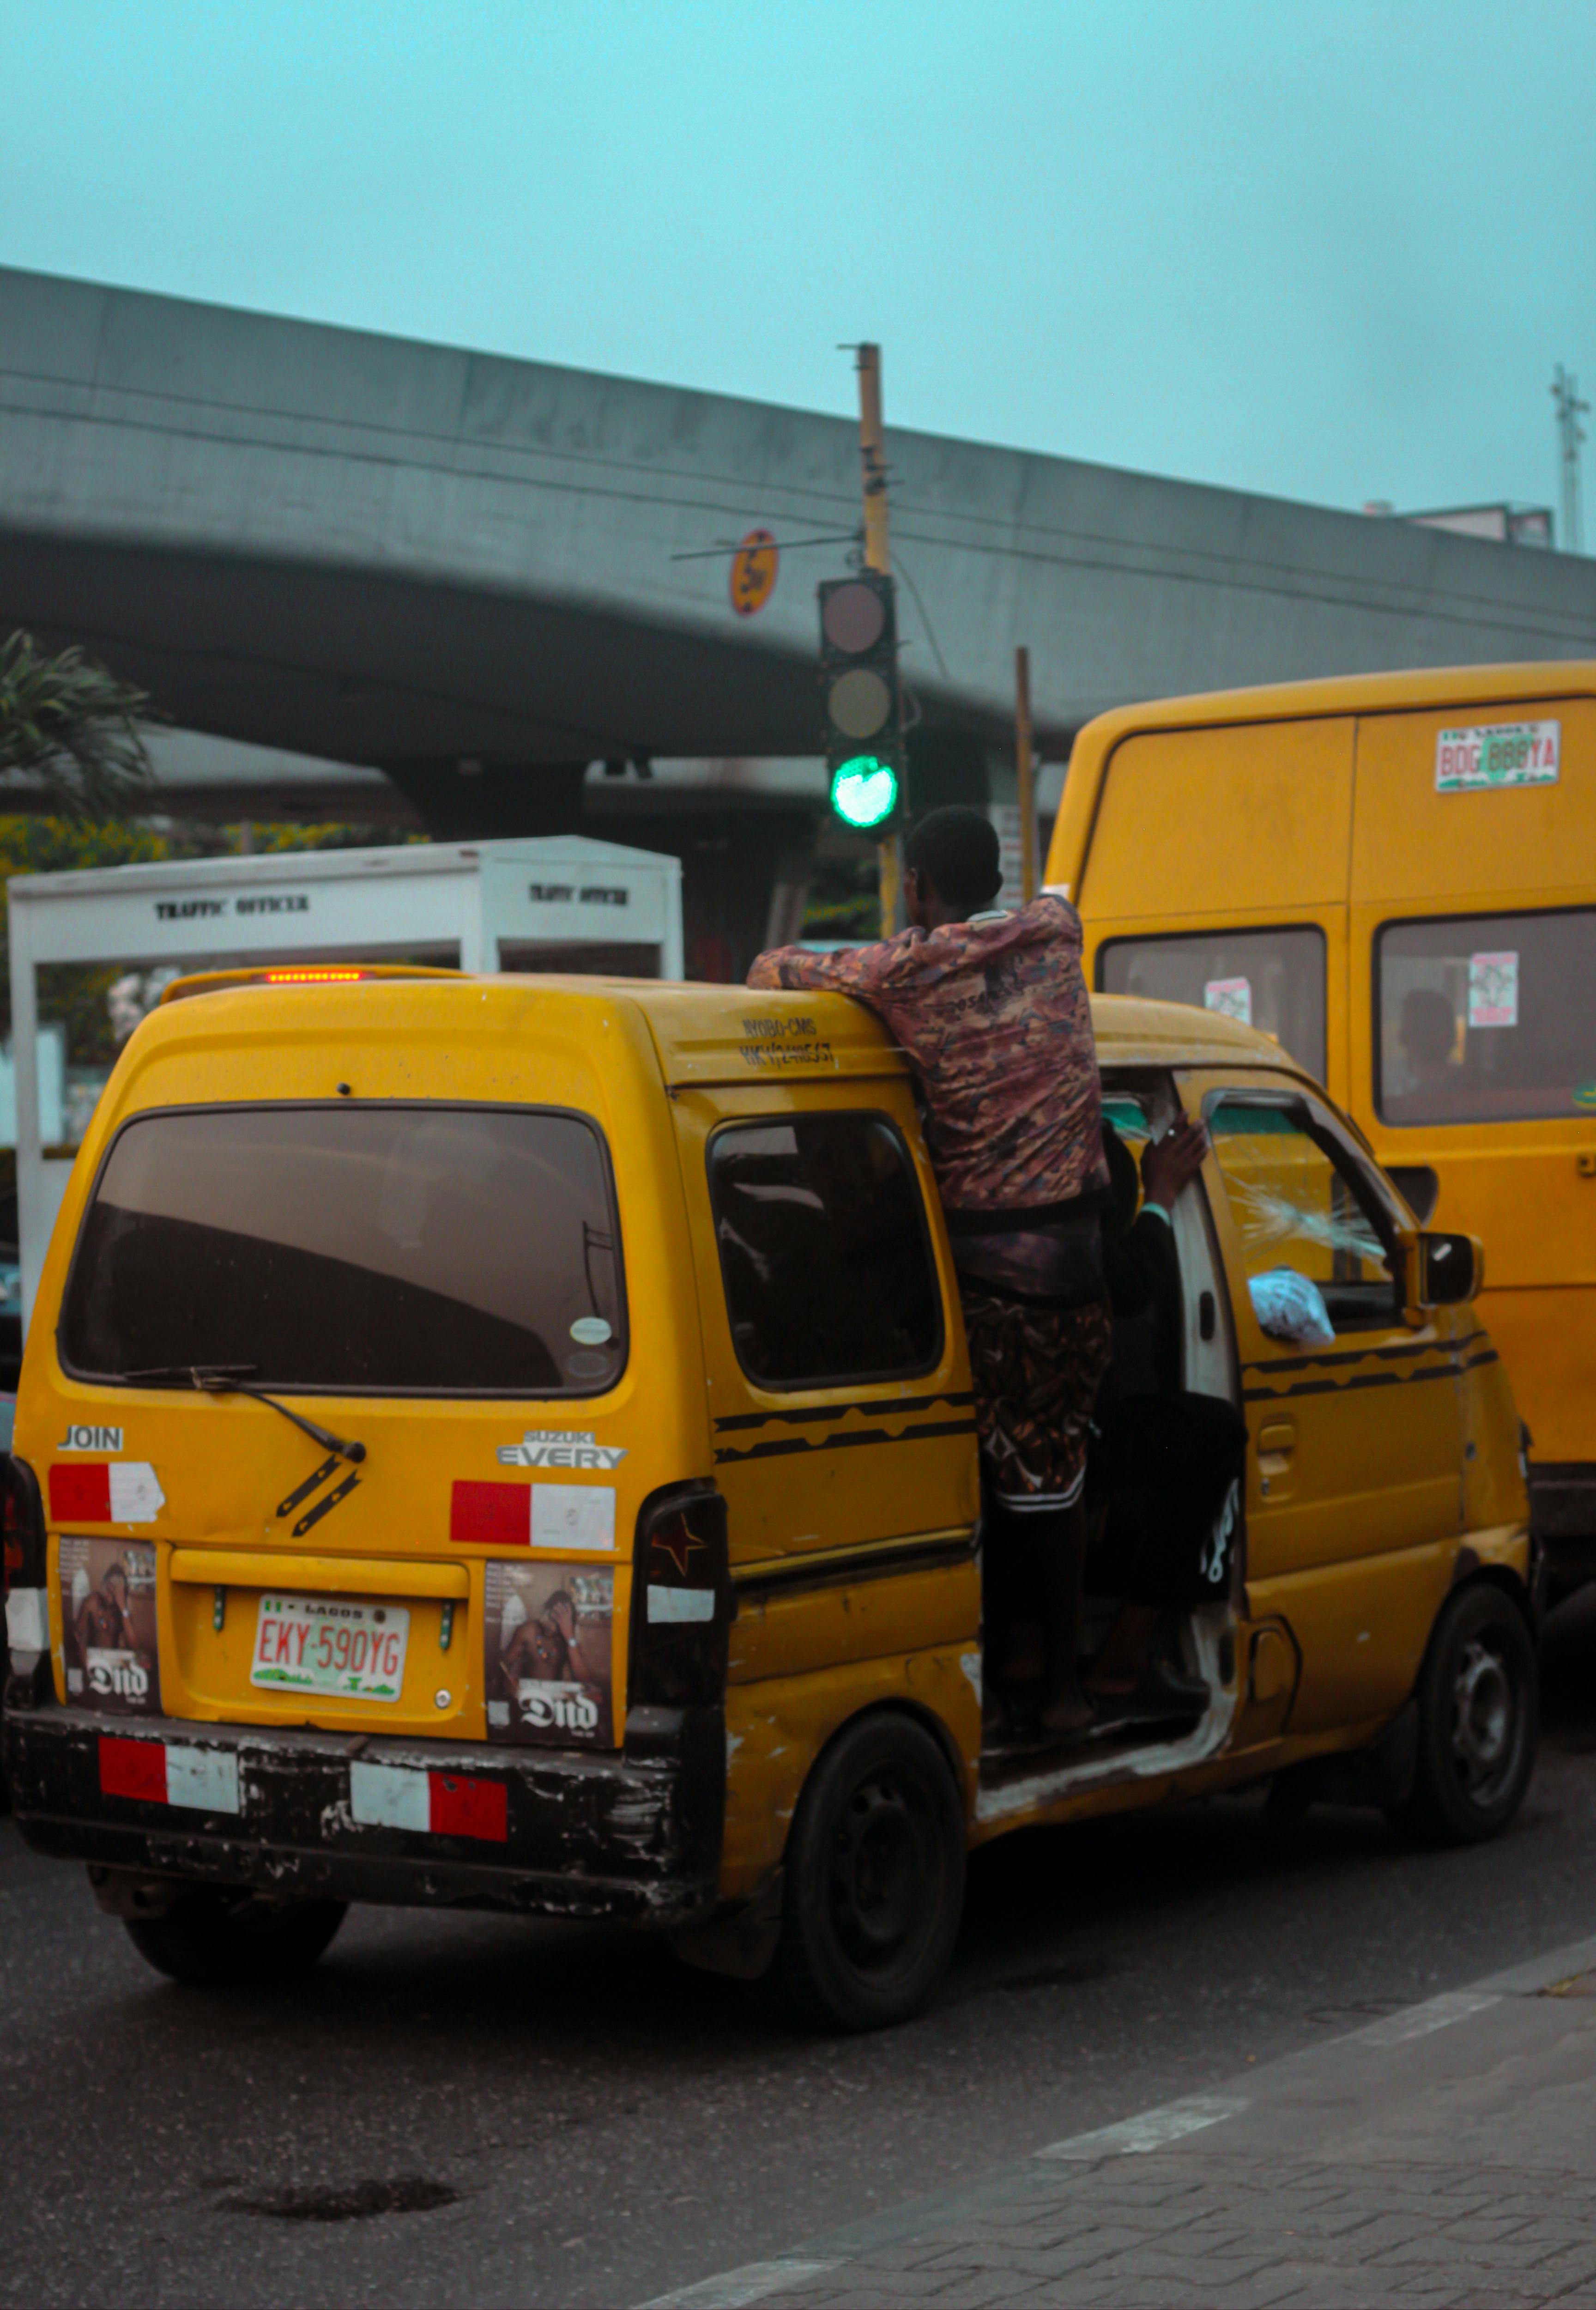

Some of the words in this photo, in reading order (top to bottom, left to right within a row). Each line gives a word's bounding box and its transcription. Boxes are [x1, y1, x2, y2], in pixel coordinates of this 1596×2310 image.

[57, 1426, 120, 1449] JOIN
[523, 1430, 595, 1443] SUZUKI
[496, 1445, 629, 1470] EVERY
[305, 1604, 363, 1620] LAGOS
